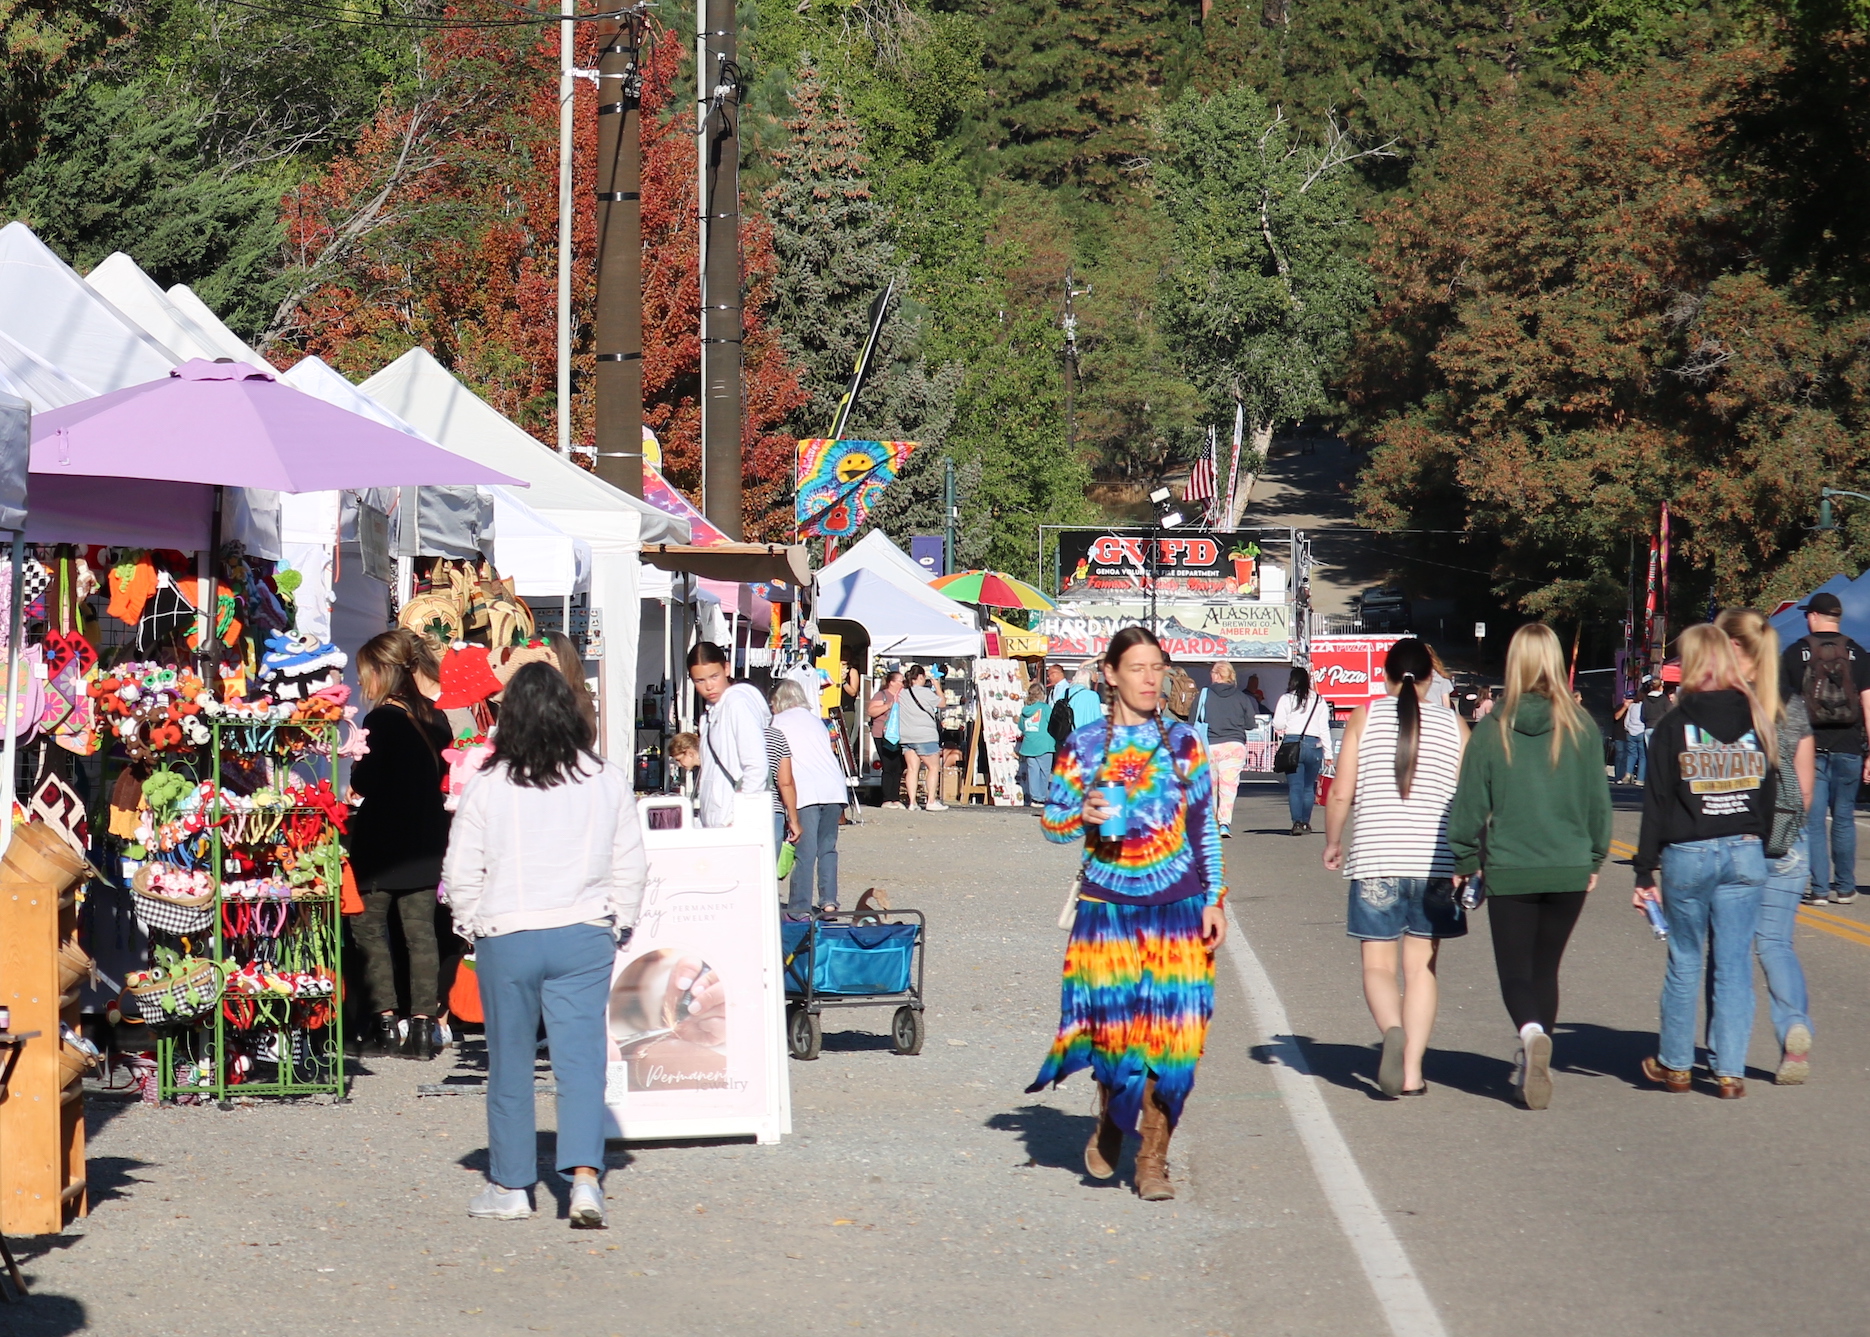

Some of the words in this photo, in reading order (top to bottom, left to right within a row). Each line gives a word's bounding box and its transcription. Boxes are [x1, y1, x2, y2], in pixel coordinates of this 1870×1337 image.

[1094, 536, 1219, 566] GVFD
[1176, 569, 1220, 577] DEPARTMENT
[1201, 606, 1286, 630] ALASKAN
[1222, 620, 1257, 628] BREWING
[1259, 620, 1272, 628] CO.
[1045, 619, 1101, 638] HARD
[1219, 628, 1251, 636] AMBER
[1252, 628, 1269, 636] ALE
[1311, 642, 1335, 652] ZZA
[1336, 642, 1375, 652] PIZZA
[1327, 665, 1368, 687] Pizza
[1678, 751, 1766, 780] BRYAN
[672, 903, 735, 912] PERMANENT
[672, 915, 716, 923] JEWELRY
[645, 1064, 737, 1088] Permanent
